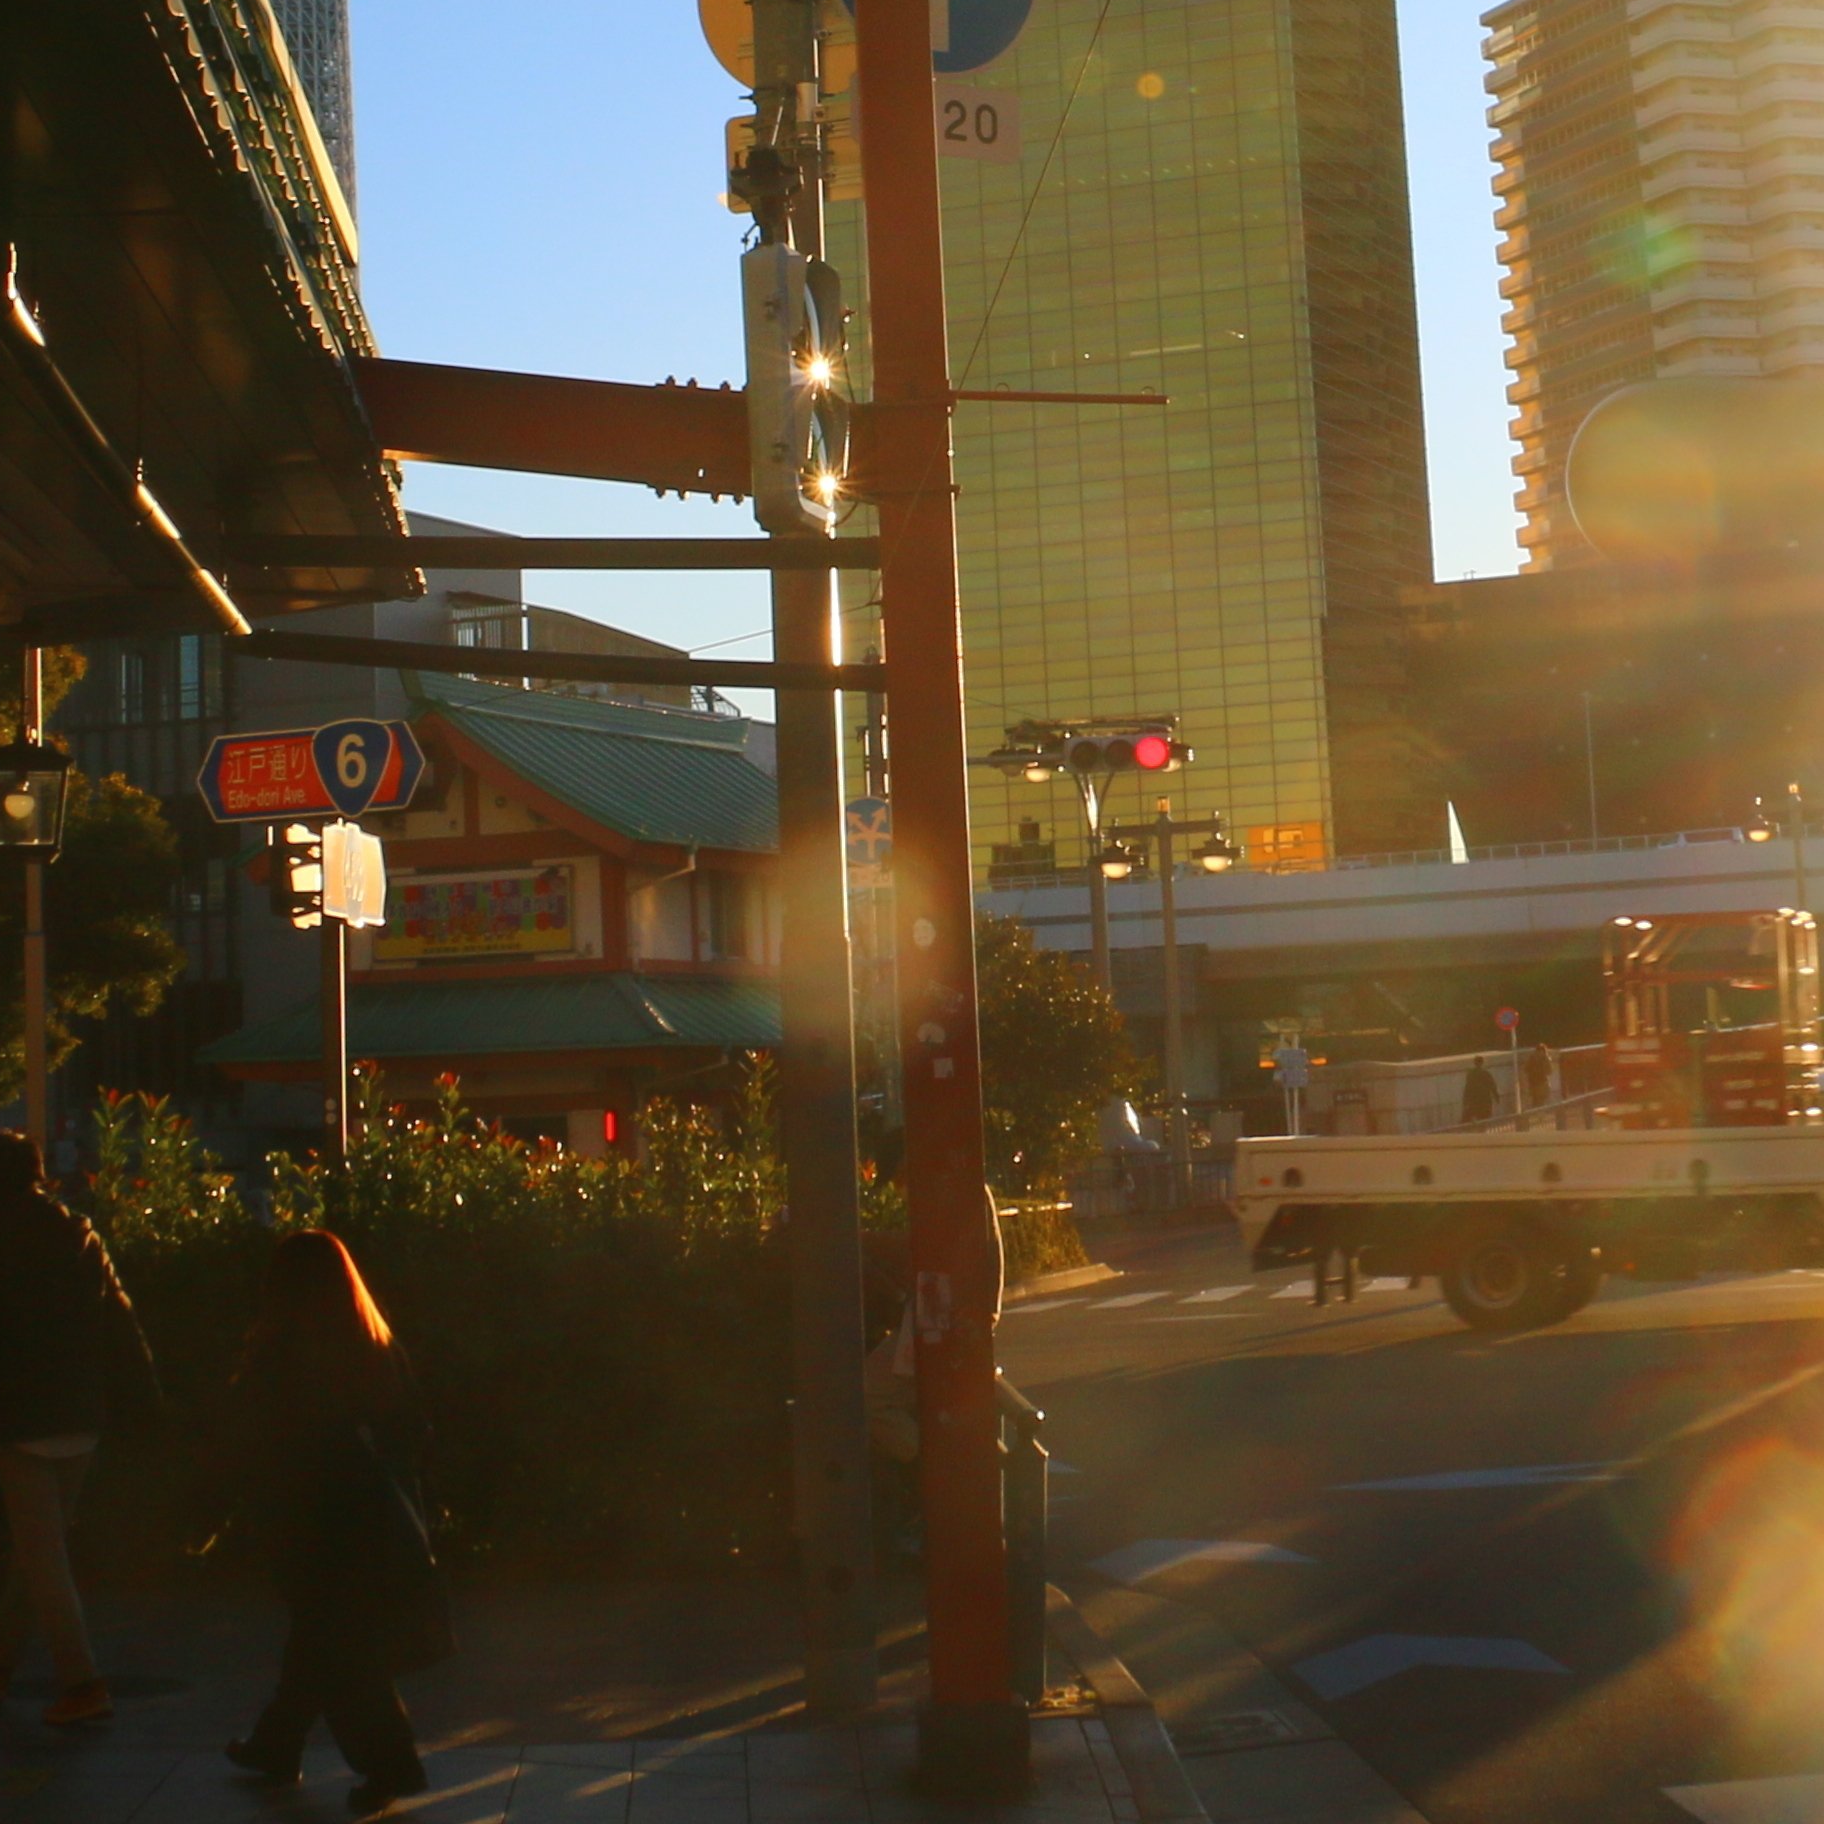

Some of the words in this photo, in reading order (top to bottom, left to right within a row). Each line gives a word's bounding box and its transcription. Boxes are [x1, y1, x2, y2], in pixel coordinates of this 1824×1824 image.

[227, 744, 308, 785] 江戸通り
[335, 732, 368, 789] 6
[227, 786, 280, 809] Edo-dori
